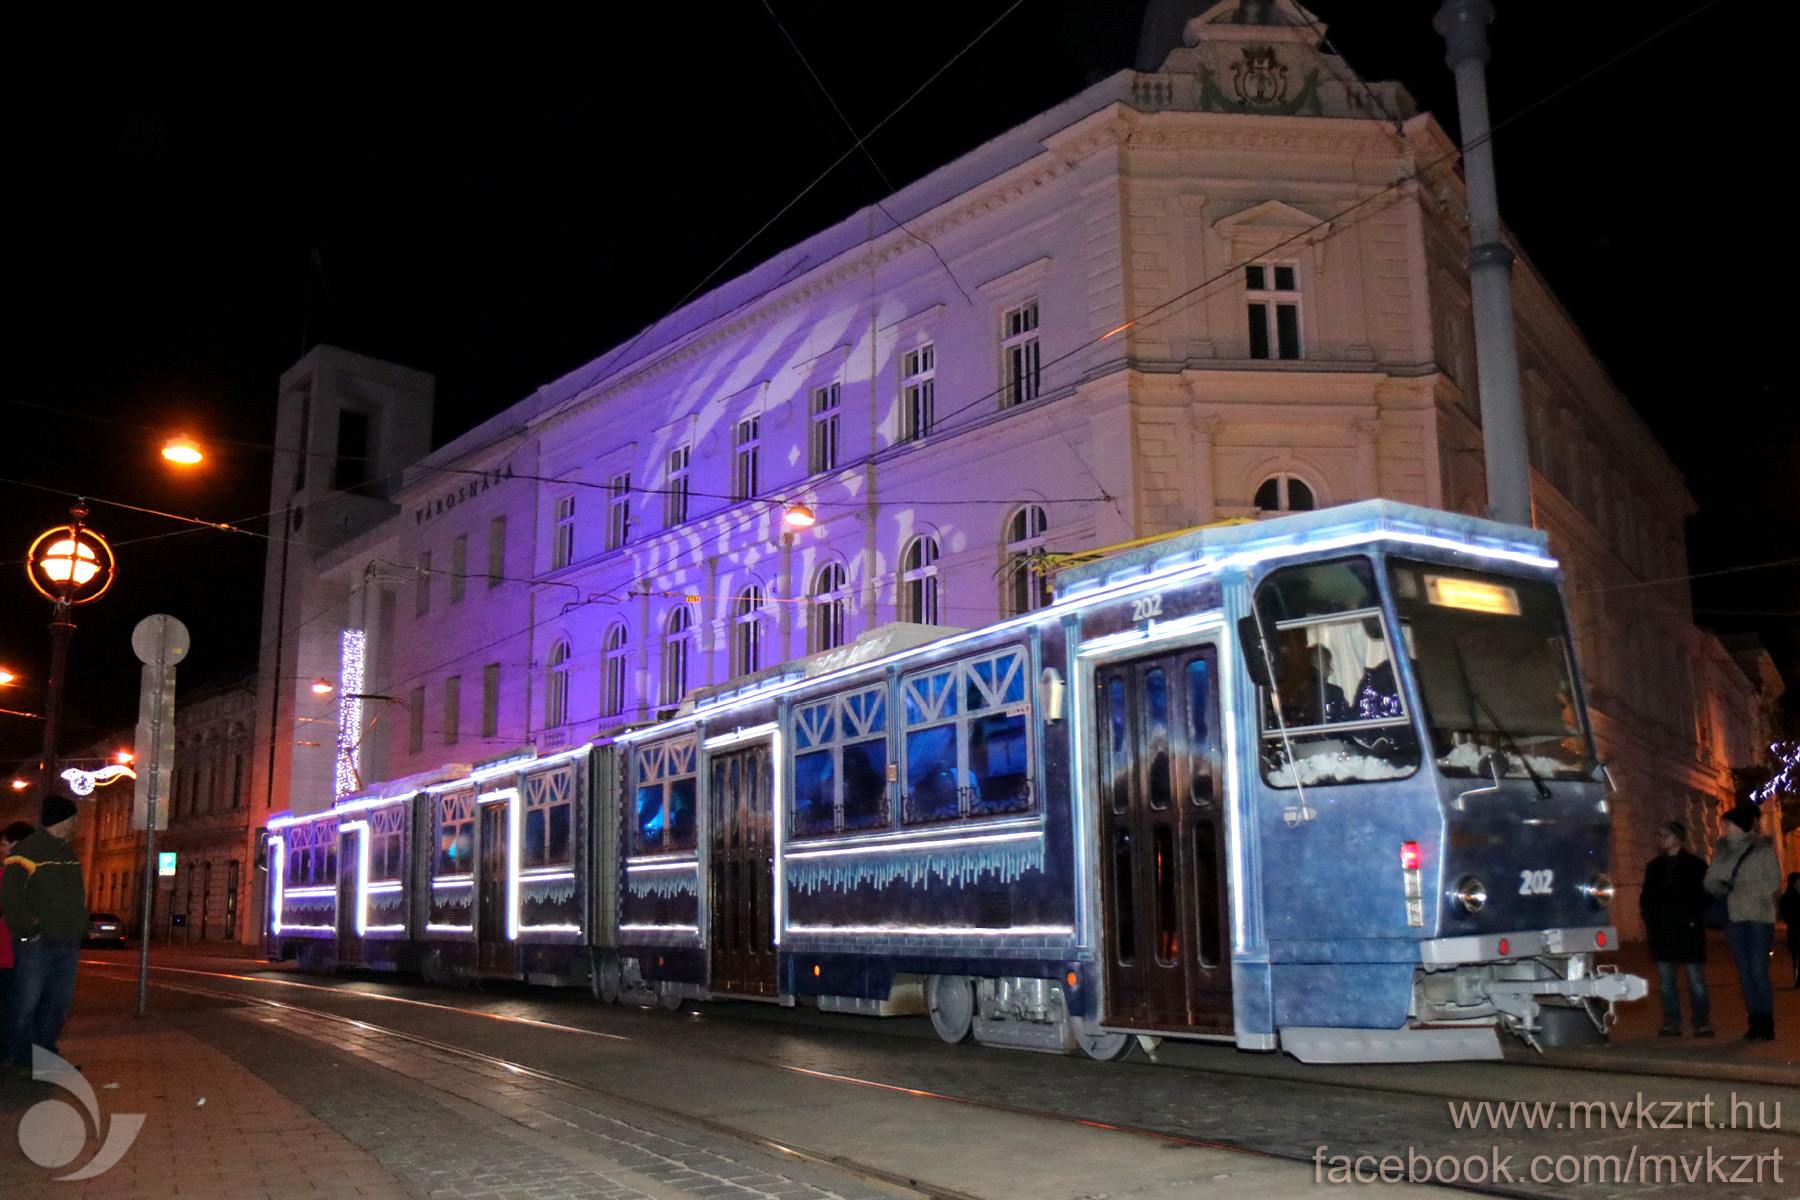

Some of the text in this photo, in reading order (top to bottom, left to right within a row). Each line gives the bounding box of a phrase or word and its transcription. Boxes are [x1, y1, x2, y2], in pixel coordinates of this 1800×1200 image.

[416, 462, 514, 525] VÁROSHÁZA
[1132, 594, 1163, 621] 202
[1519, 869, 1553, 895] 202
